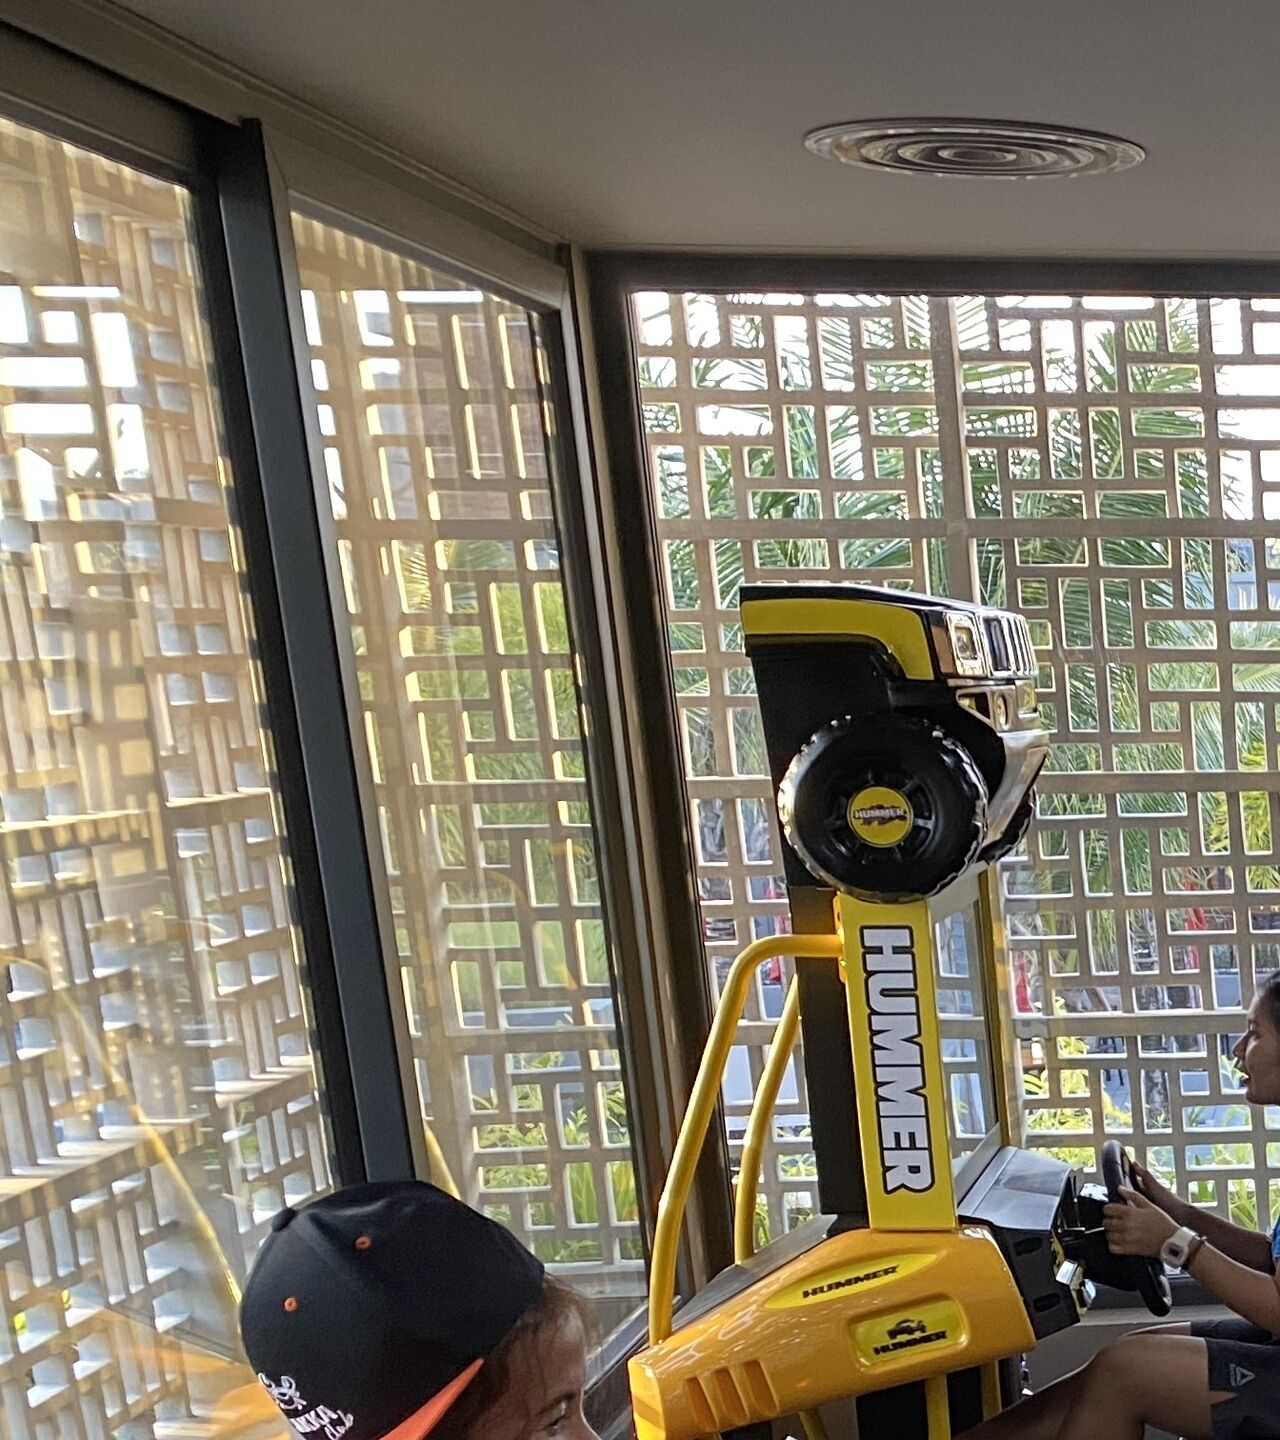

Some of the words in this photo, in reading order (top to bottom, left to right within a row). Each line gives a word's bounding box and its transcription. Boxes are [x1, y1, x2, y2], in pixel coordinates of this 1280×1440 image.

[859, 925, 936, 1194] HUMMER
[802, 1265, 898, 1299] HUMMER
[873, 1330, 947, 1356] HUMMER
